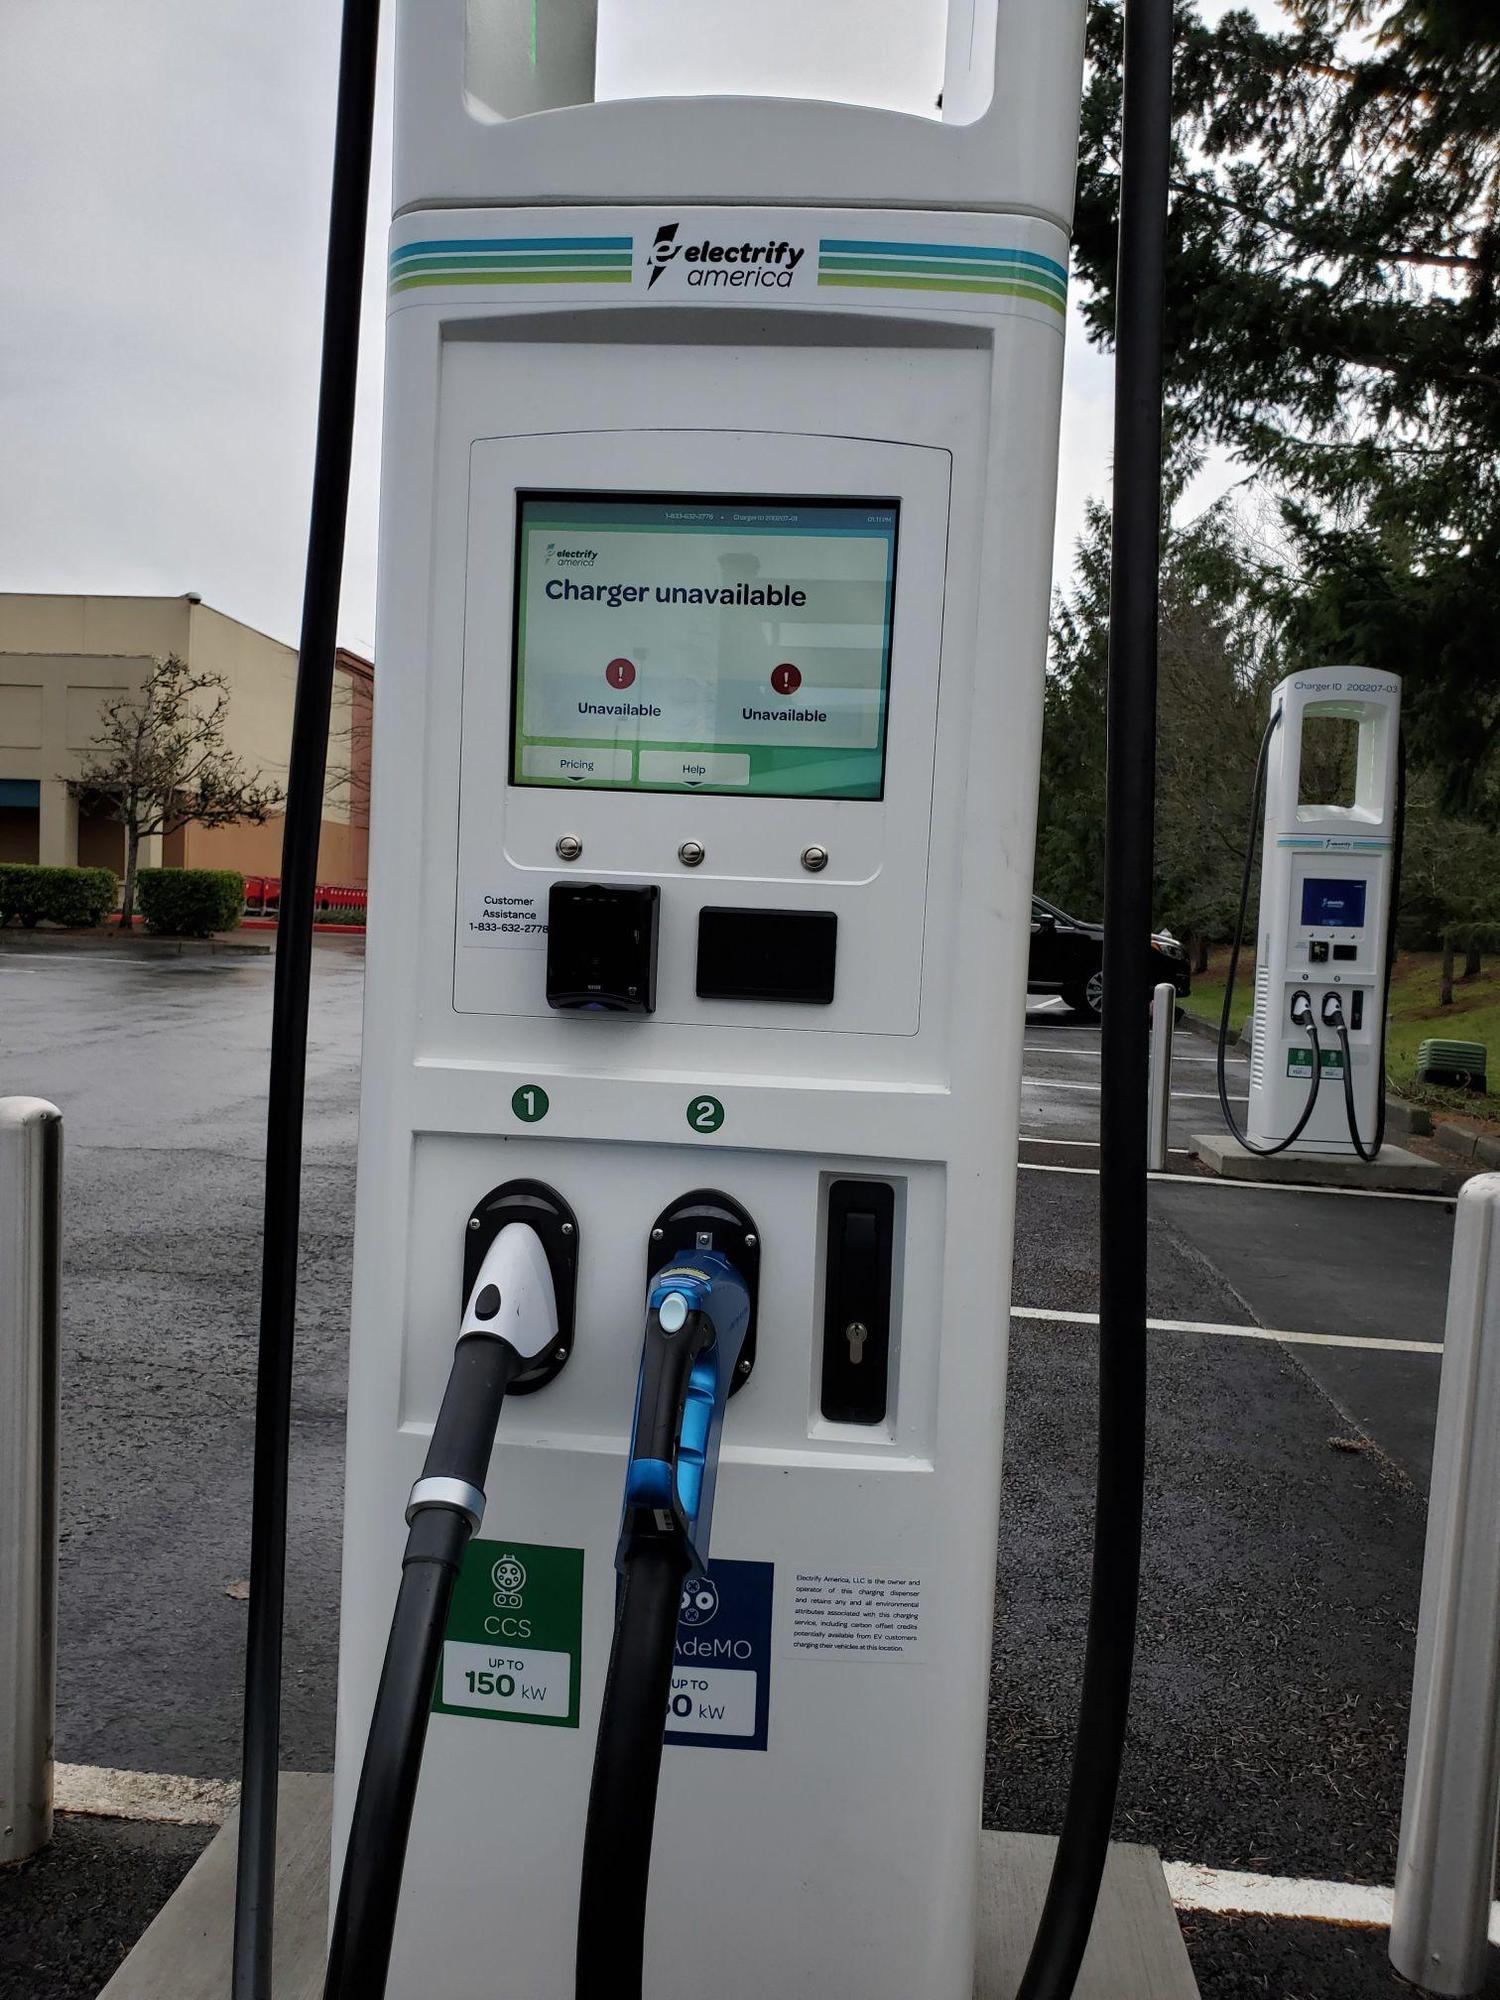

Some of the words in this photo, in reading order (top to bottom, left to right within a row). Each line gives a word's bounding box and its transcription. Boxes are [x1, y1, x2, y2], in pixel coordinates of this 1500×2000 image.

[684, 240, 805, 269] electrify
[687, 267, 794, 287] america
[556, 549, 598, 559] electrify
[557, 558, 595, 567] america
[545, 578, 650, 607] Charger
[655, 583, 807, 606] unavailable
[1294, 681, 1331, 693] Charger
[1332, 682, 1342, 692] ID
[578, 702, 661, 716] Unavailable
[742, 708, 827, 722] Unavailable
[559, 759, 594, 771] Pricing
[682, 764, 706, 776] Help
[484, 895, 534, 906] Customer
[482, 909, 537, 920] Assistance
[469, 922, 549, 934] 1-833-632-2778
[522, 1090, 535, 1116] 1
[695, 1101, 715, 1127] 2
[796, 1574, 822, 1583] Electrify
[795, 1586, 822, 1594] operator
[858, 1588, 885, 1597] charging
[834, 1599, 846, 1607] any
[892, 1612, 919, 1621] charging
[483, 1615, 532, 1638] CCS
[820, 1620, 848, 1629] including
[856, 1632, 872, 1640] from
[793, 1641, 819, 1650] charging
[488, 1658, 505, 1669] UP
[506, 1660, 524, 1671] TO
[465, 1670, 516, 1697] 150
[521, 1684, 547, 1701] kW
[671, 1679, 688, 1689] UP
[690, 1680, 709, 1691] TO
[666, 1693, 692, 1718] 0
[698, 1703, 725, 1720] kW
